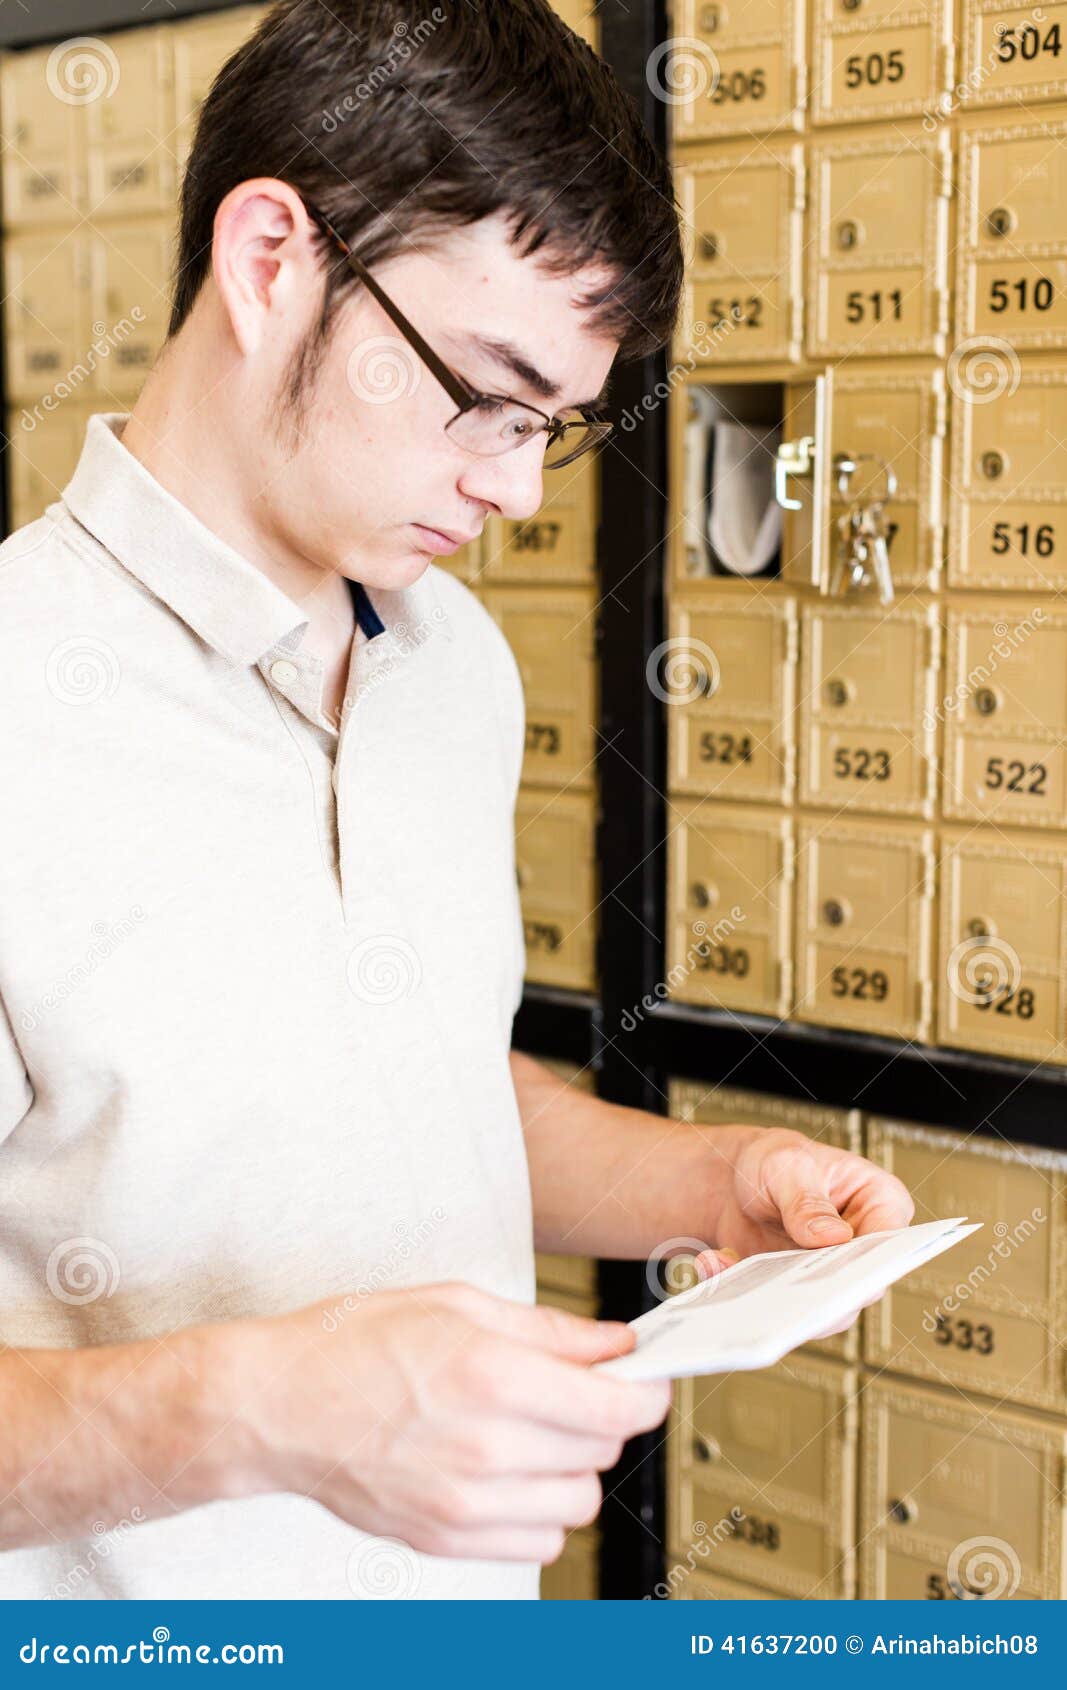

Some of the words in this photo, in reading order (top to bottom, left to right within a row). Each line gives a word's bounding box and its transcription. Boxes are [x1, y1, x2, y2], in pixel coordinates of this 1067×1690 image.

[997, 23, 1061, 63] 504
[711, 69, 766, 104] 506
[845, 51, 905, 89] 505
[846, 290, 902, 324] 511
[988, 277, 1054, 313] 510
[708, 297, 763, 329] 512
[991, 524, 1055, 557] 516
[525, 722, 560, 756] 73
[701, 732, 753, 766] 524
[833, 748, 892, 782] 523
[985, 757, 1048, 796] 522
[525, 921, 562, 955] 79
[831, 967, 889, 1002] 529
[974, 980, 1036, 1019] 528
[934, 1314, 995, 1355] 533
